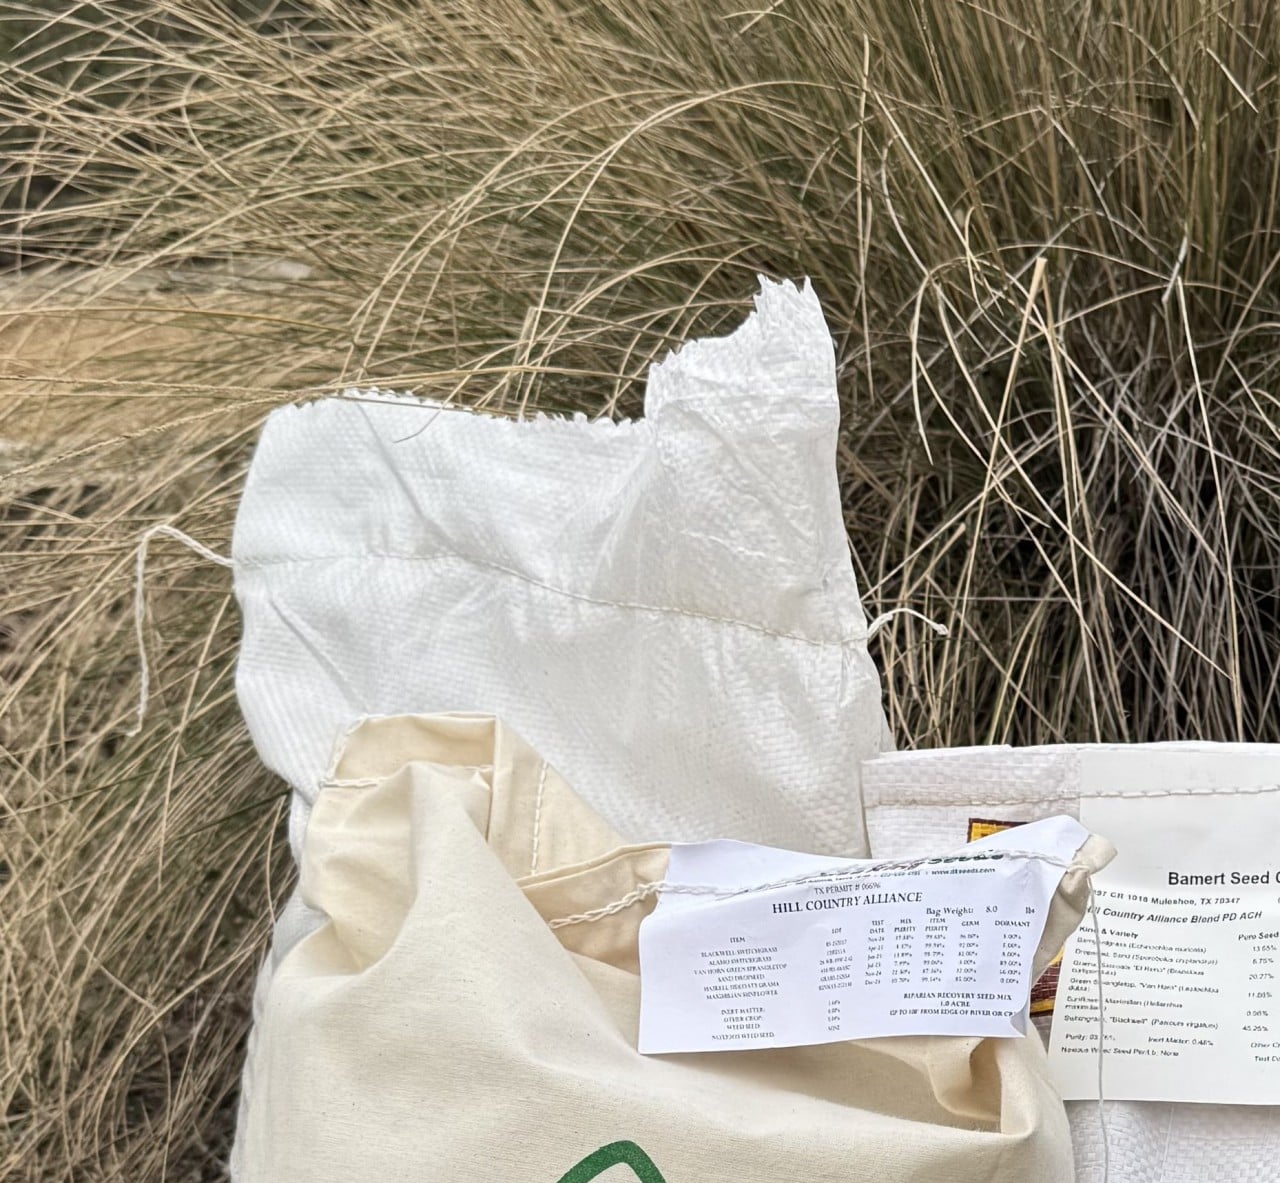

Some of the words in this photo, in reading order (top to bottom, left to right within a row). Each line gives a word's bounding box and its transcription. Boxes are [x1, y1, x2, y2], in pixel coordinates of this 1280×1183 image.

[1168, 871, 1224, 886] Bamert
[1230, 871, 1269, 885] Seed
[826, 884, 852, 894] PERMIT
[772, 901, 803, 914] HILL
[805, 895, 861, 911] COUNTRY
[863, 892, 922, 905] ALLIANCE
[1103, 907, 1144, 922] Country
[1146, 914, 1187, 924] Alliance
[1191, 914, 1220, 924] Blend
[1222, 912, 1237, 922] PD
[1239, 911, 1262, 920] ACH
